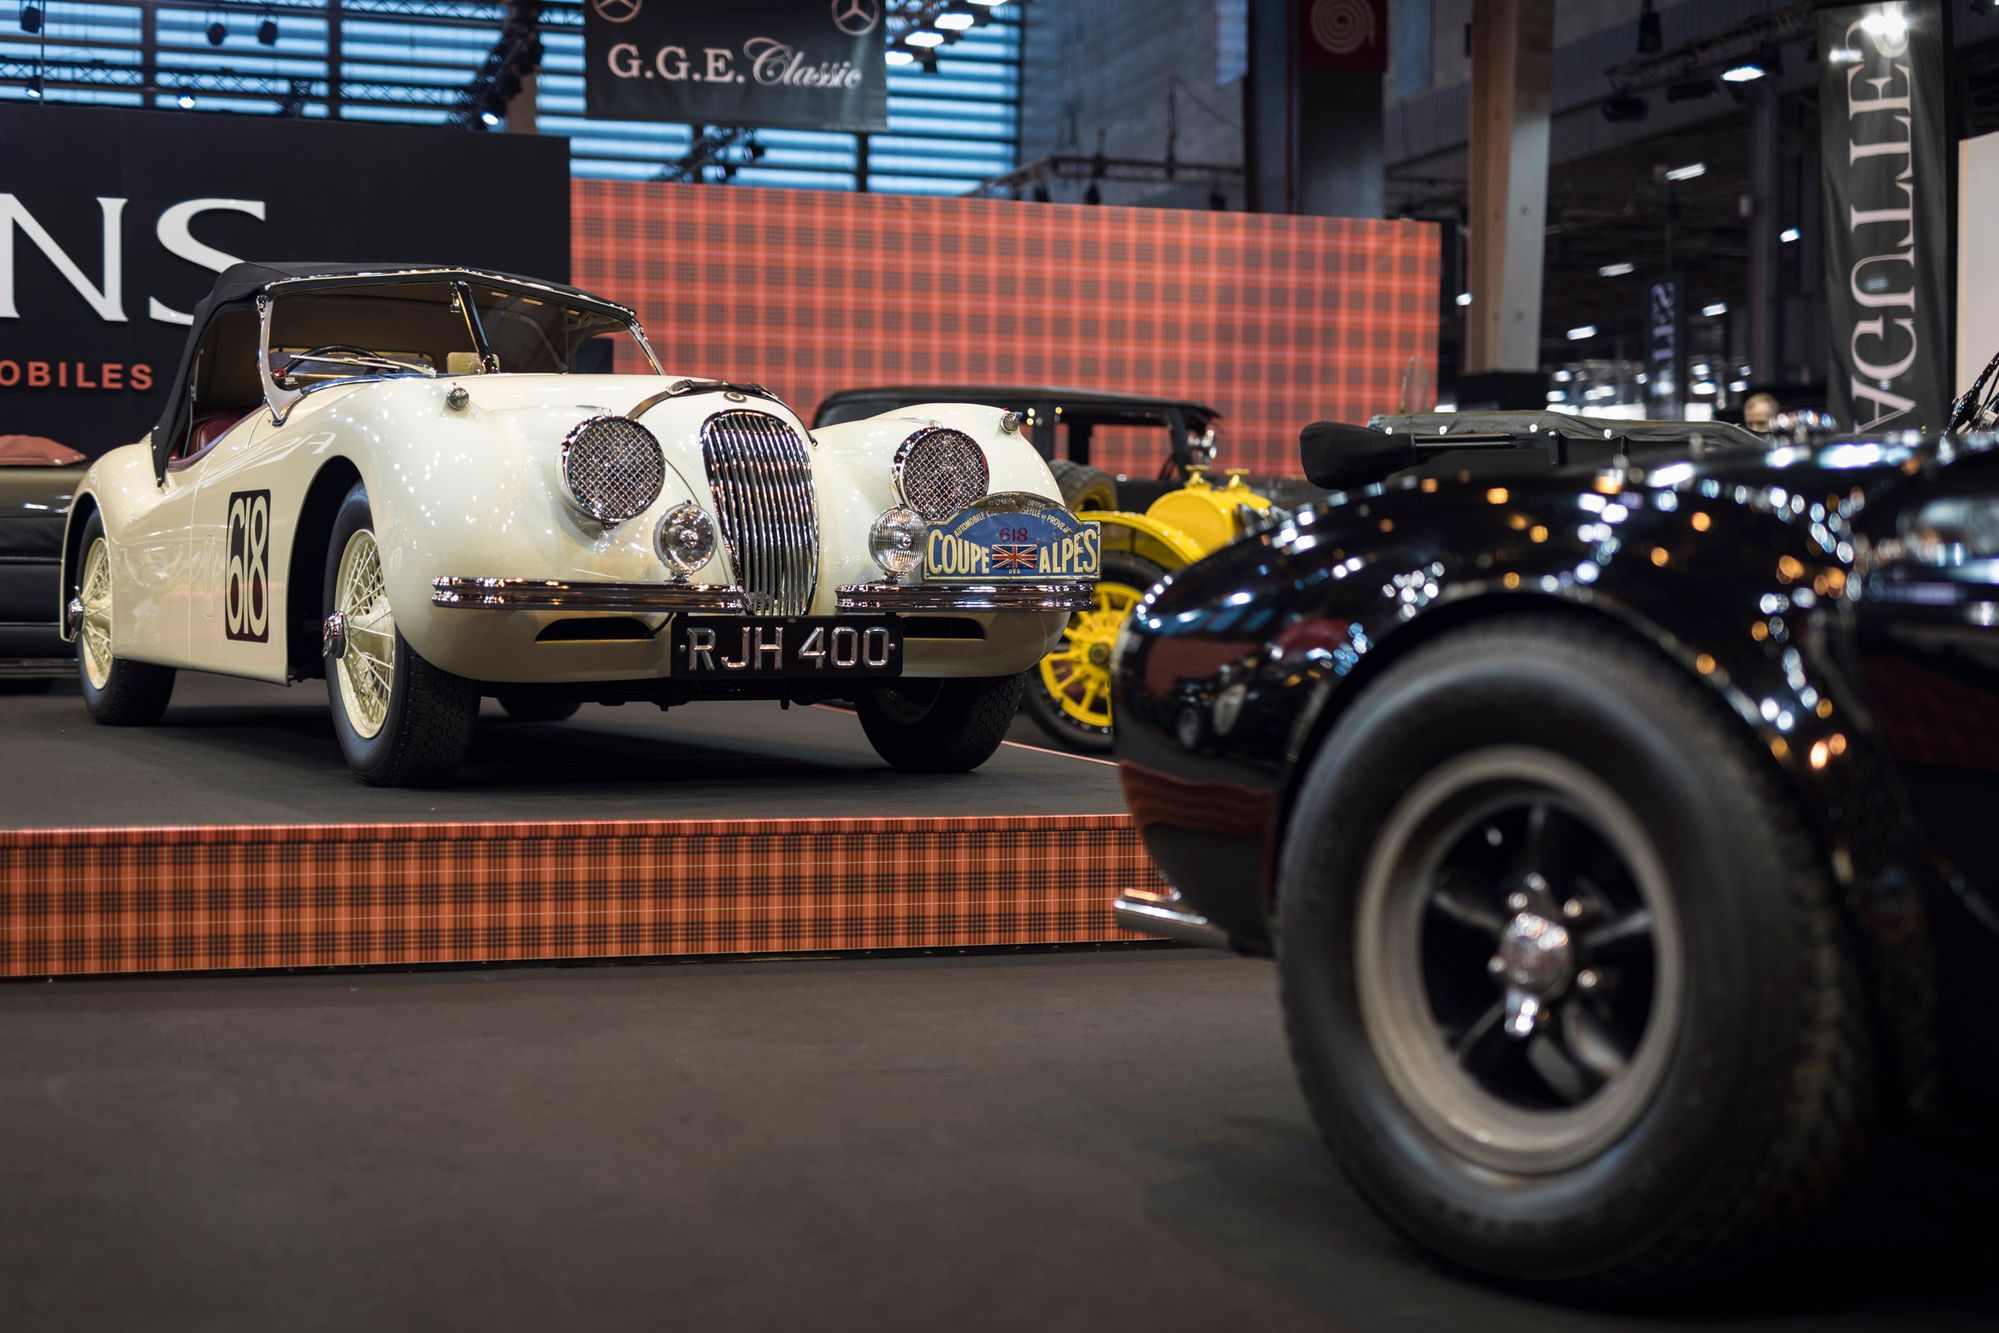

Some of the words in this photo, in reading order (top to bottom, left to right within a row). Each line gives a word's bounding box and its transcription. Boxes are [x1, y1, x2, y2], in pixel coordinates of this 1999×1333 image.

[607, 43, 745, 84] G.G.E.
[743, 36, 863, 88] Classic
[953, 511, 986, 538] AUTOMOBILE
[998, 527, 1028, 543] 618
[226, 495, 268, 637] 618
[928, 529, 990, 575] COUPE
[1038, 528, 1098, 574] ALPES
[686, 626, 784, 671] RJH
[798, 626, 891, 669] 400
